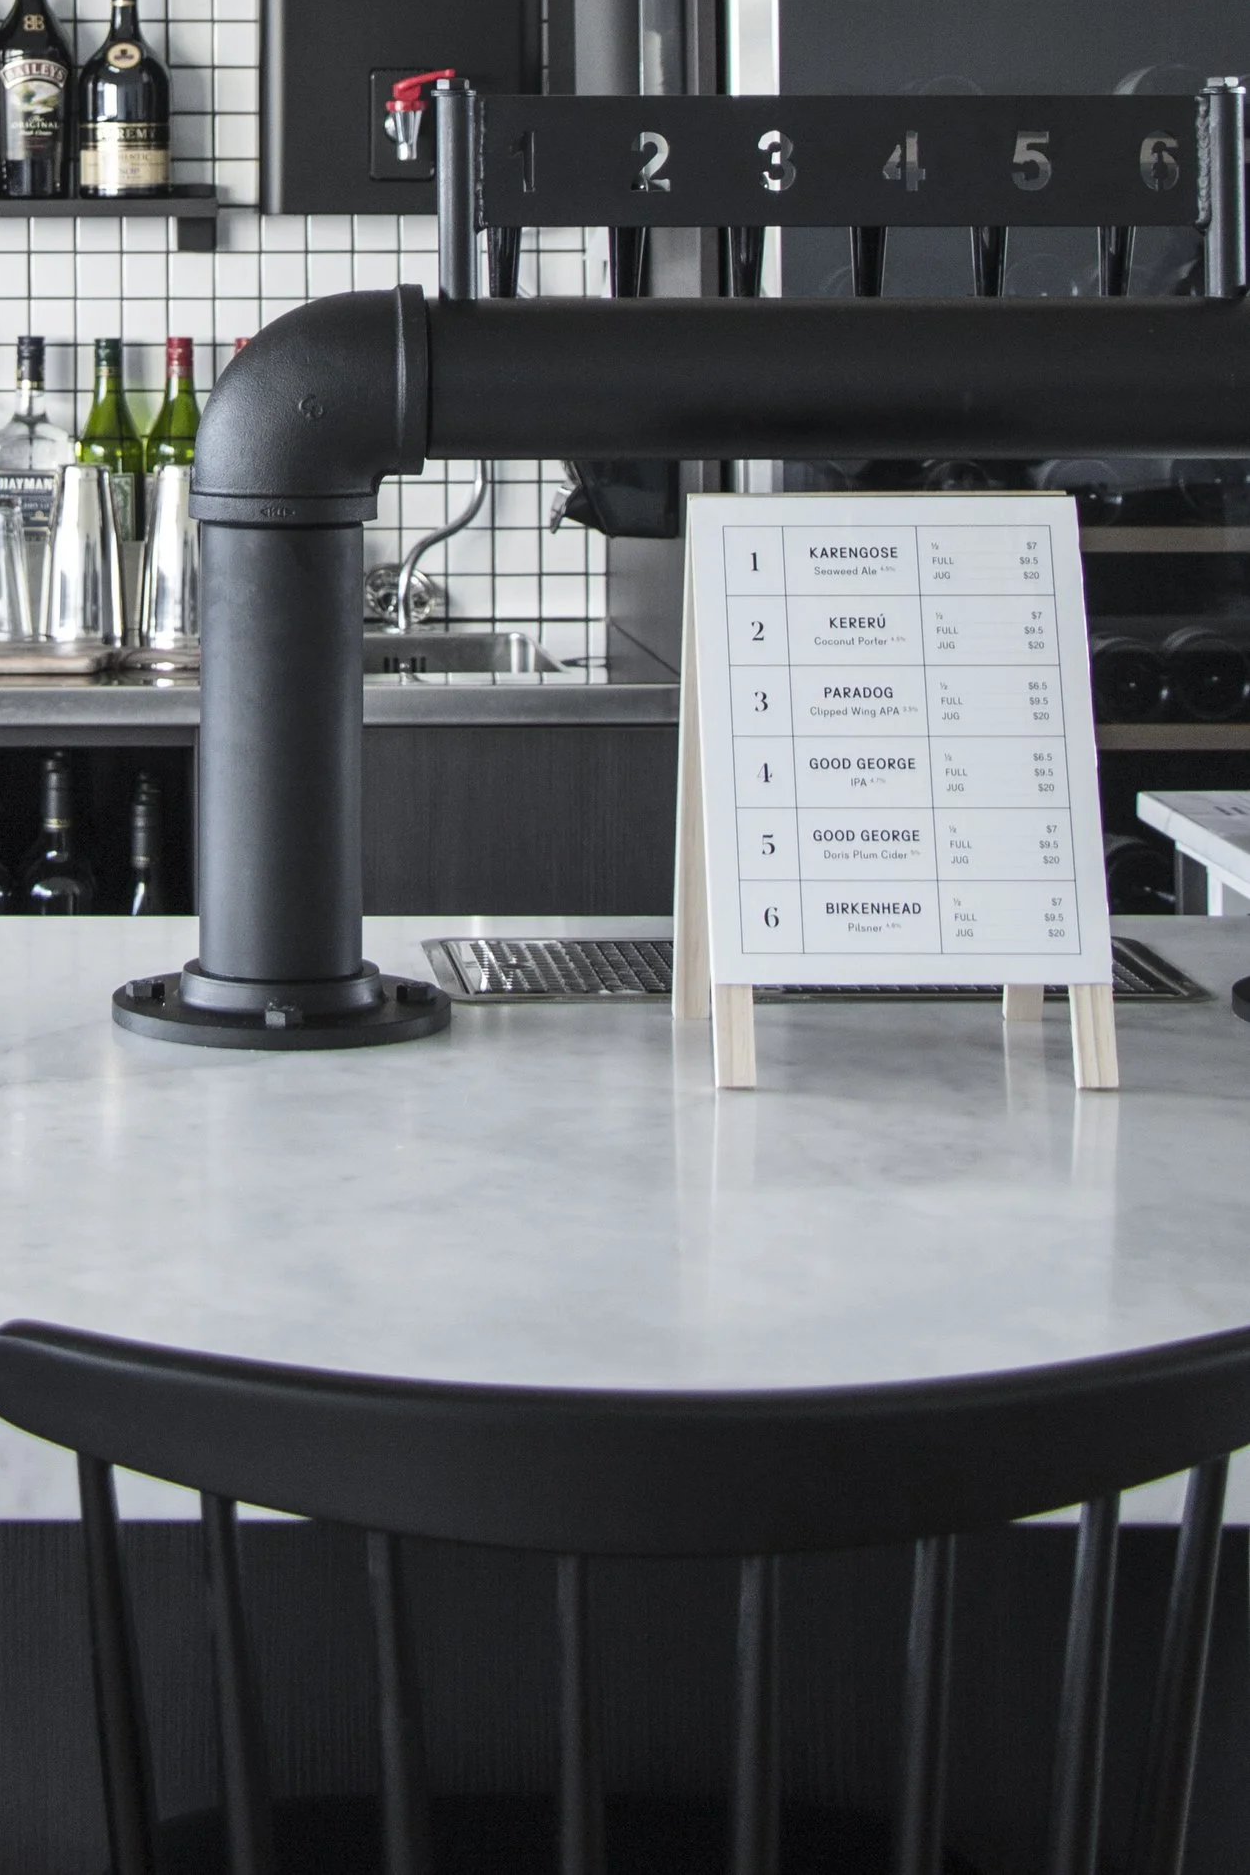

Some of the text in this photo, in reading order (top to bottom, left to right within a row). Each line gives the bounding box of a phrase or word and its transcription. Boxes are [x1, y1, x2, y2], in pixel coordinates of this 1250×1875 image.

[4, 61, 65, 83] BAILEYS
[509, 130, 1180, 193] 1 2 3 4 5 6
[1026, 541, 1038, 551] $7
[809, 547, 899, 559] KARENGOSE
[750, 552, 759, 572] 1
[932, 557, 1038, 565] FULL $9.5
[814, 566, 858, 576] Seaweed
[861, 566, 877, 576] Ale
[932, 571, 1040, 580] JUG $20
[1031, 611, 1042, 620] $7
[829, 613, 886, 629] KERERÚ
[751, 621, 764, 641] 2
[936, 627, 1044, 635] FULL $9.5
[814, 636, 855, 646] Coconut
[858, 636, 888, 646] Porter
[937, 641, 1044, 650] JUG $20
[1028, 681, 1048, 691] $6.5
[823, 687, 894, 699] PARADOG
[754, 691, 769, 712] 3
[940, 697, 1048, 705] FULL $9.5
[810, 707, 849, 718] Clipped
[851, 707, 877, 718] Wing
[879, 707, 900, 716] APA
[942, 712, 1050, 721] JUG $20
[1032, 753, 1052, 762] $6.5
[809, 758, 916, 770] GOOD GEORGE
[757, 762, 773, 783] 4
[945, 768, 1054, 777] FULL $9.5
[850, 778, 867, 787] IPA
[946, 783, 1054, 793] JUG $20
[1046, 825, 1058, 834] $7
[813, 830, 921, 842] GOOD GEORGE
[761, 834, 776, 856] 5
[950, 841, 1058, 849] FULL $9.5
[823, 850, 850, 860] Doris
[853, 850, 878, 860] Plum
[880, 850, 908, 860] Cider
[951, 855, 1060, 865] JUG $20
[1051, 898, 1062, 907] $7
[826, 902, 922, 915] BIRKENHEAD
[763, 906, 780, 929] 6
[954, 913, 1064, 922] FULL $9.5
[847, 923, 883, 933] Pilsner
[956, 929, 1065, 937] JUG $20
